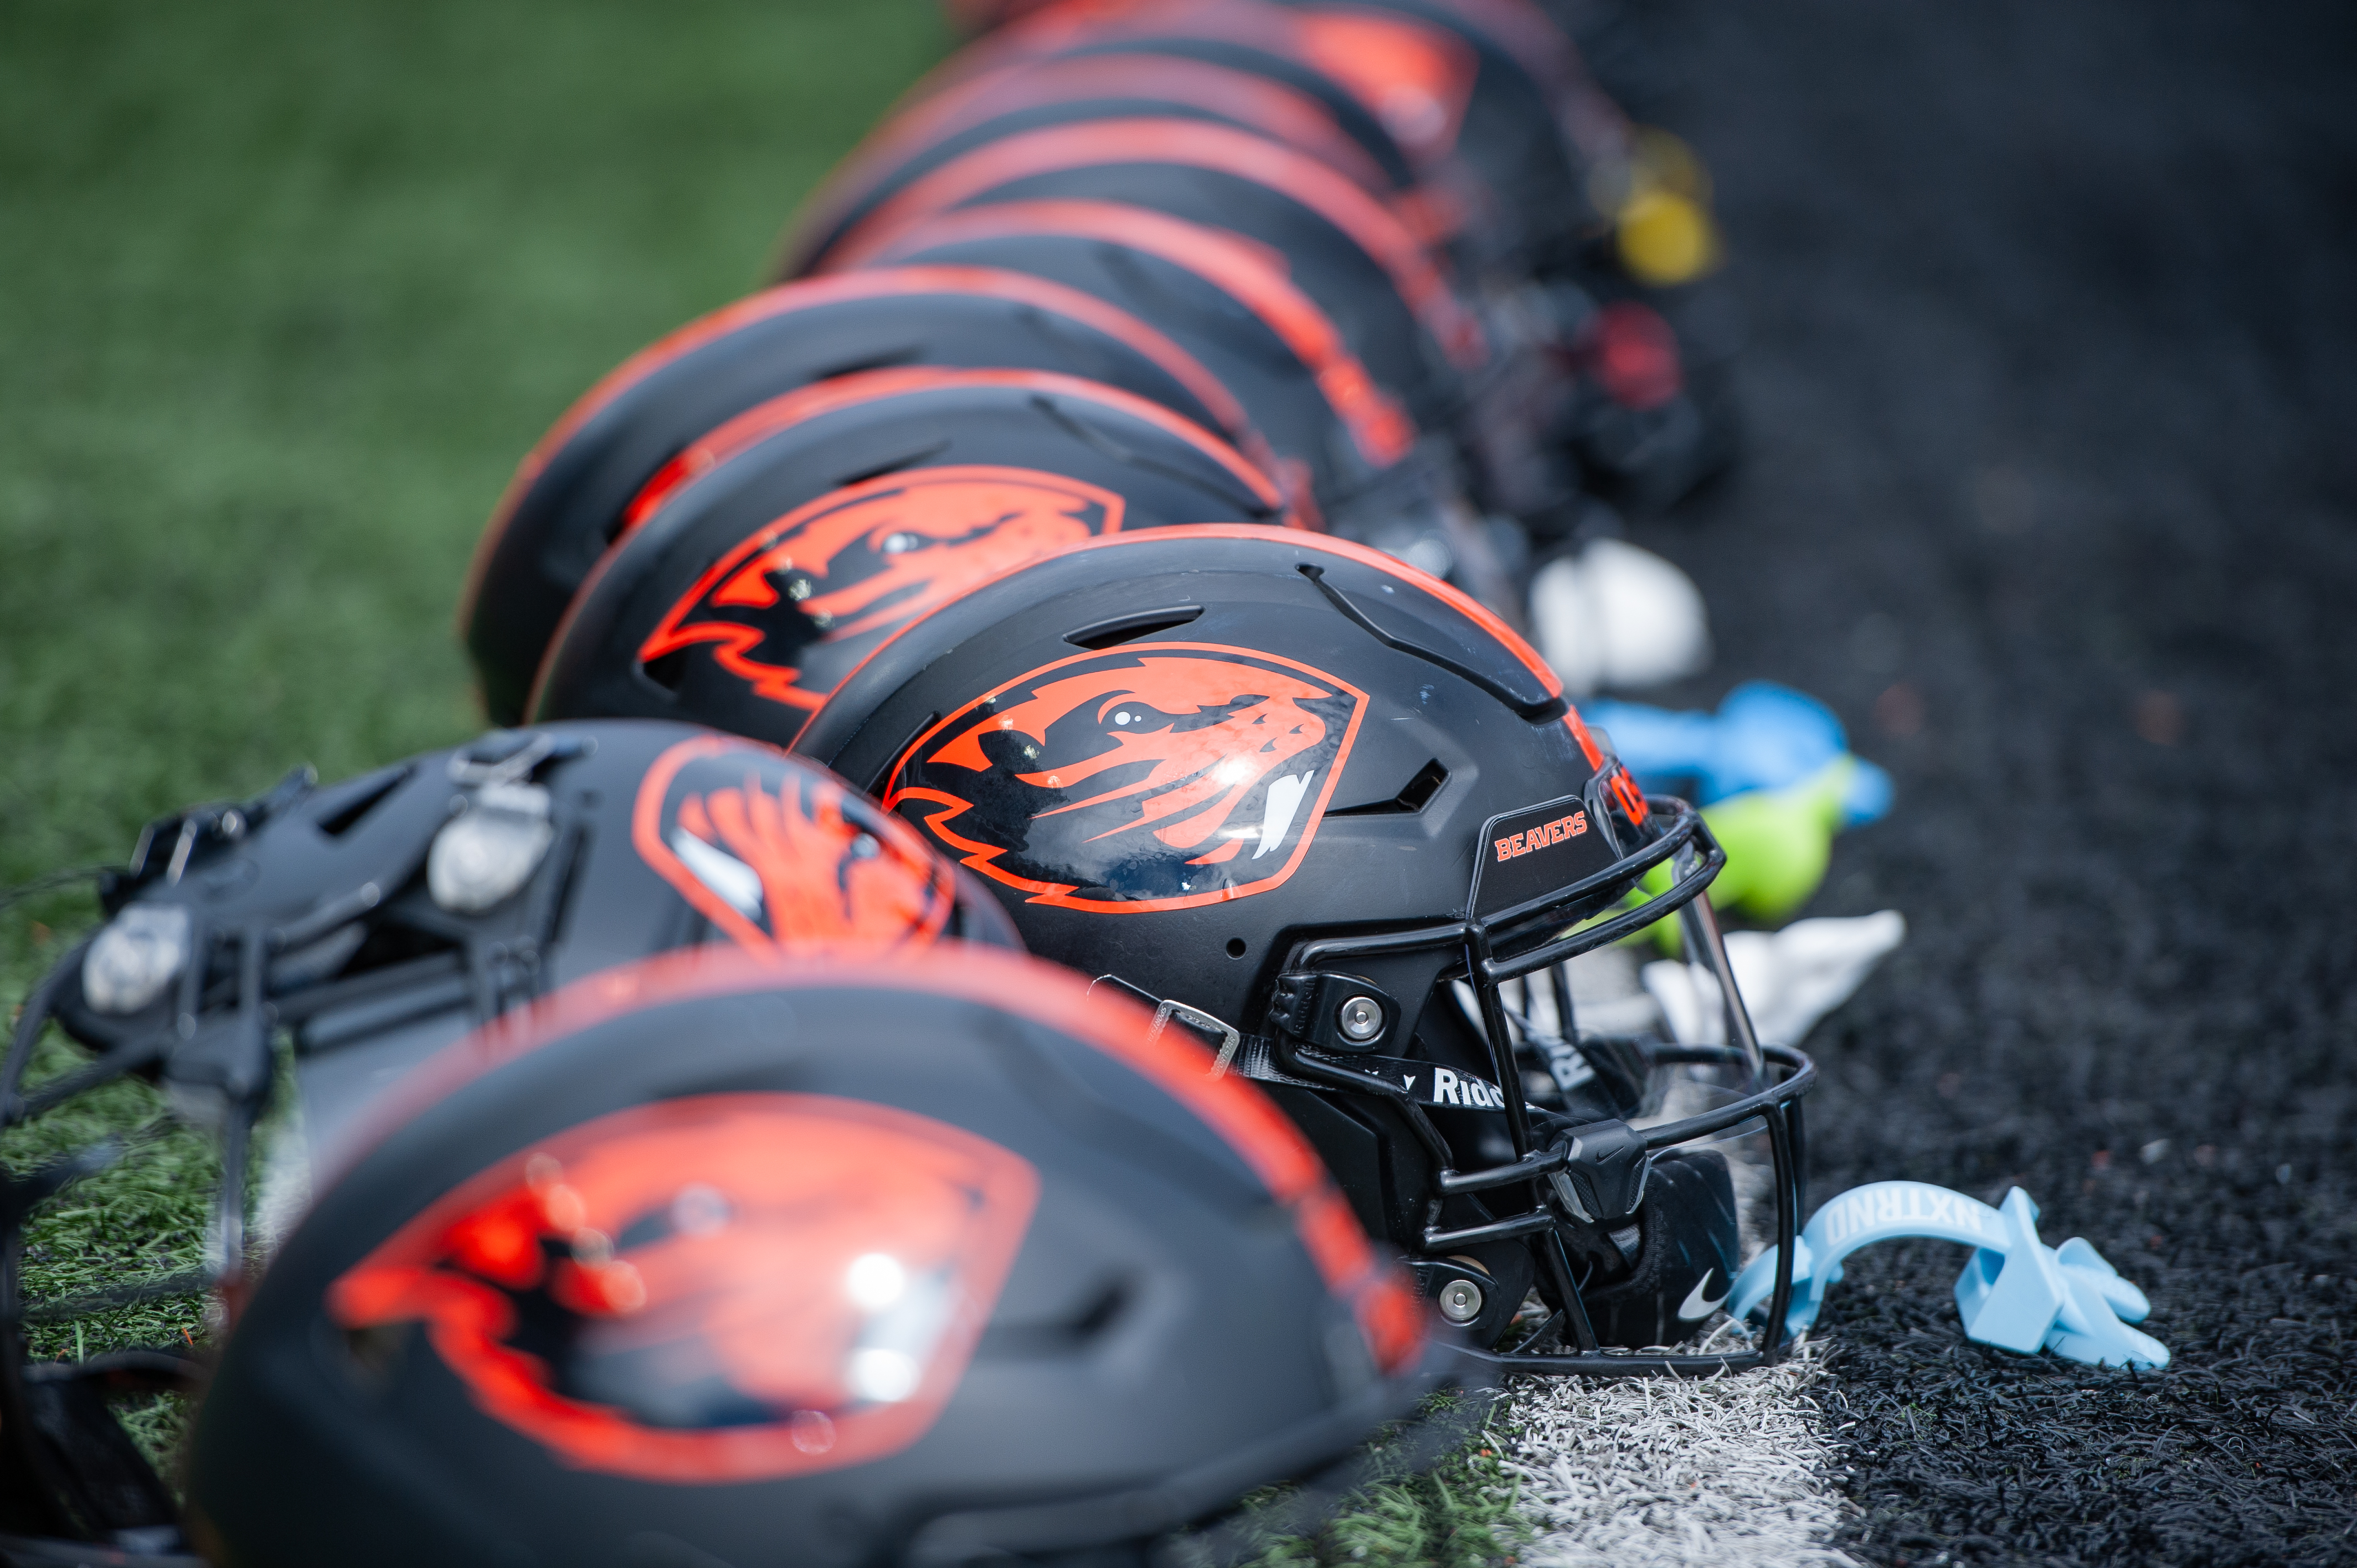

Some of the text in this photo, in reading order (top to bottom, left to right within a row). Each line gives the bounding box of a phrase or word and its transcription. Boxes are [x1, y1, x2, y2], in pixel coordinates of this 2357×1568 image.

[1494, 811, 1587, 862] BEAVERS
[1293, 979, 1316, 1034] Riddell
[1826, 1187, 1983, 1246] NXTRND
